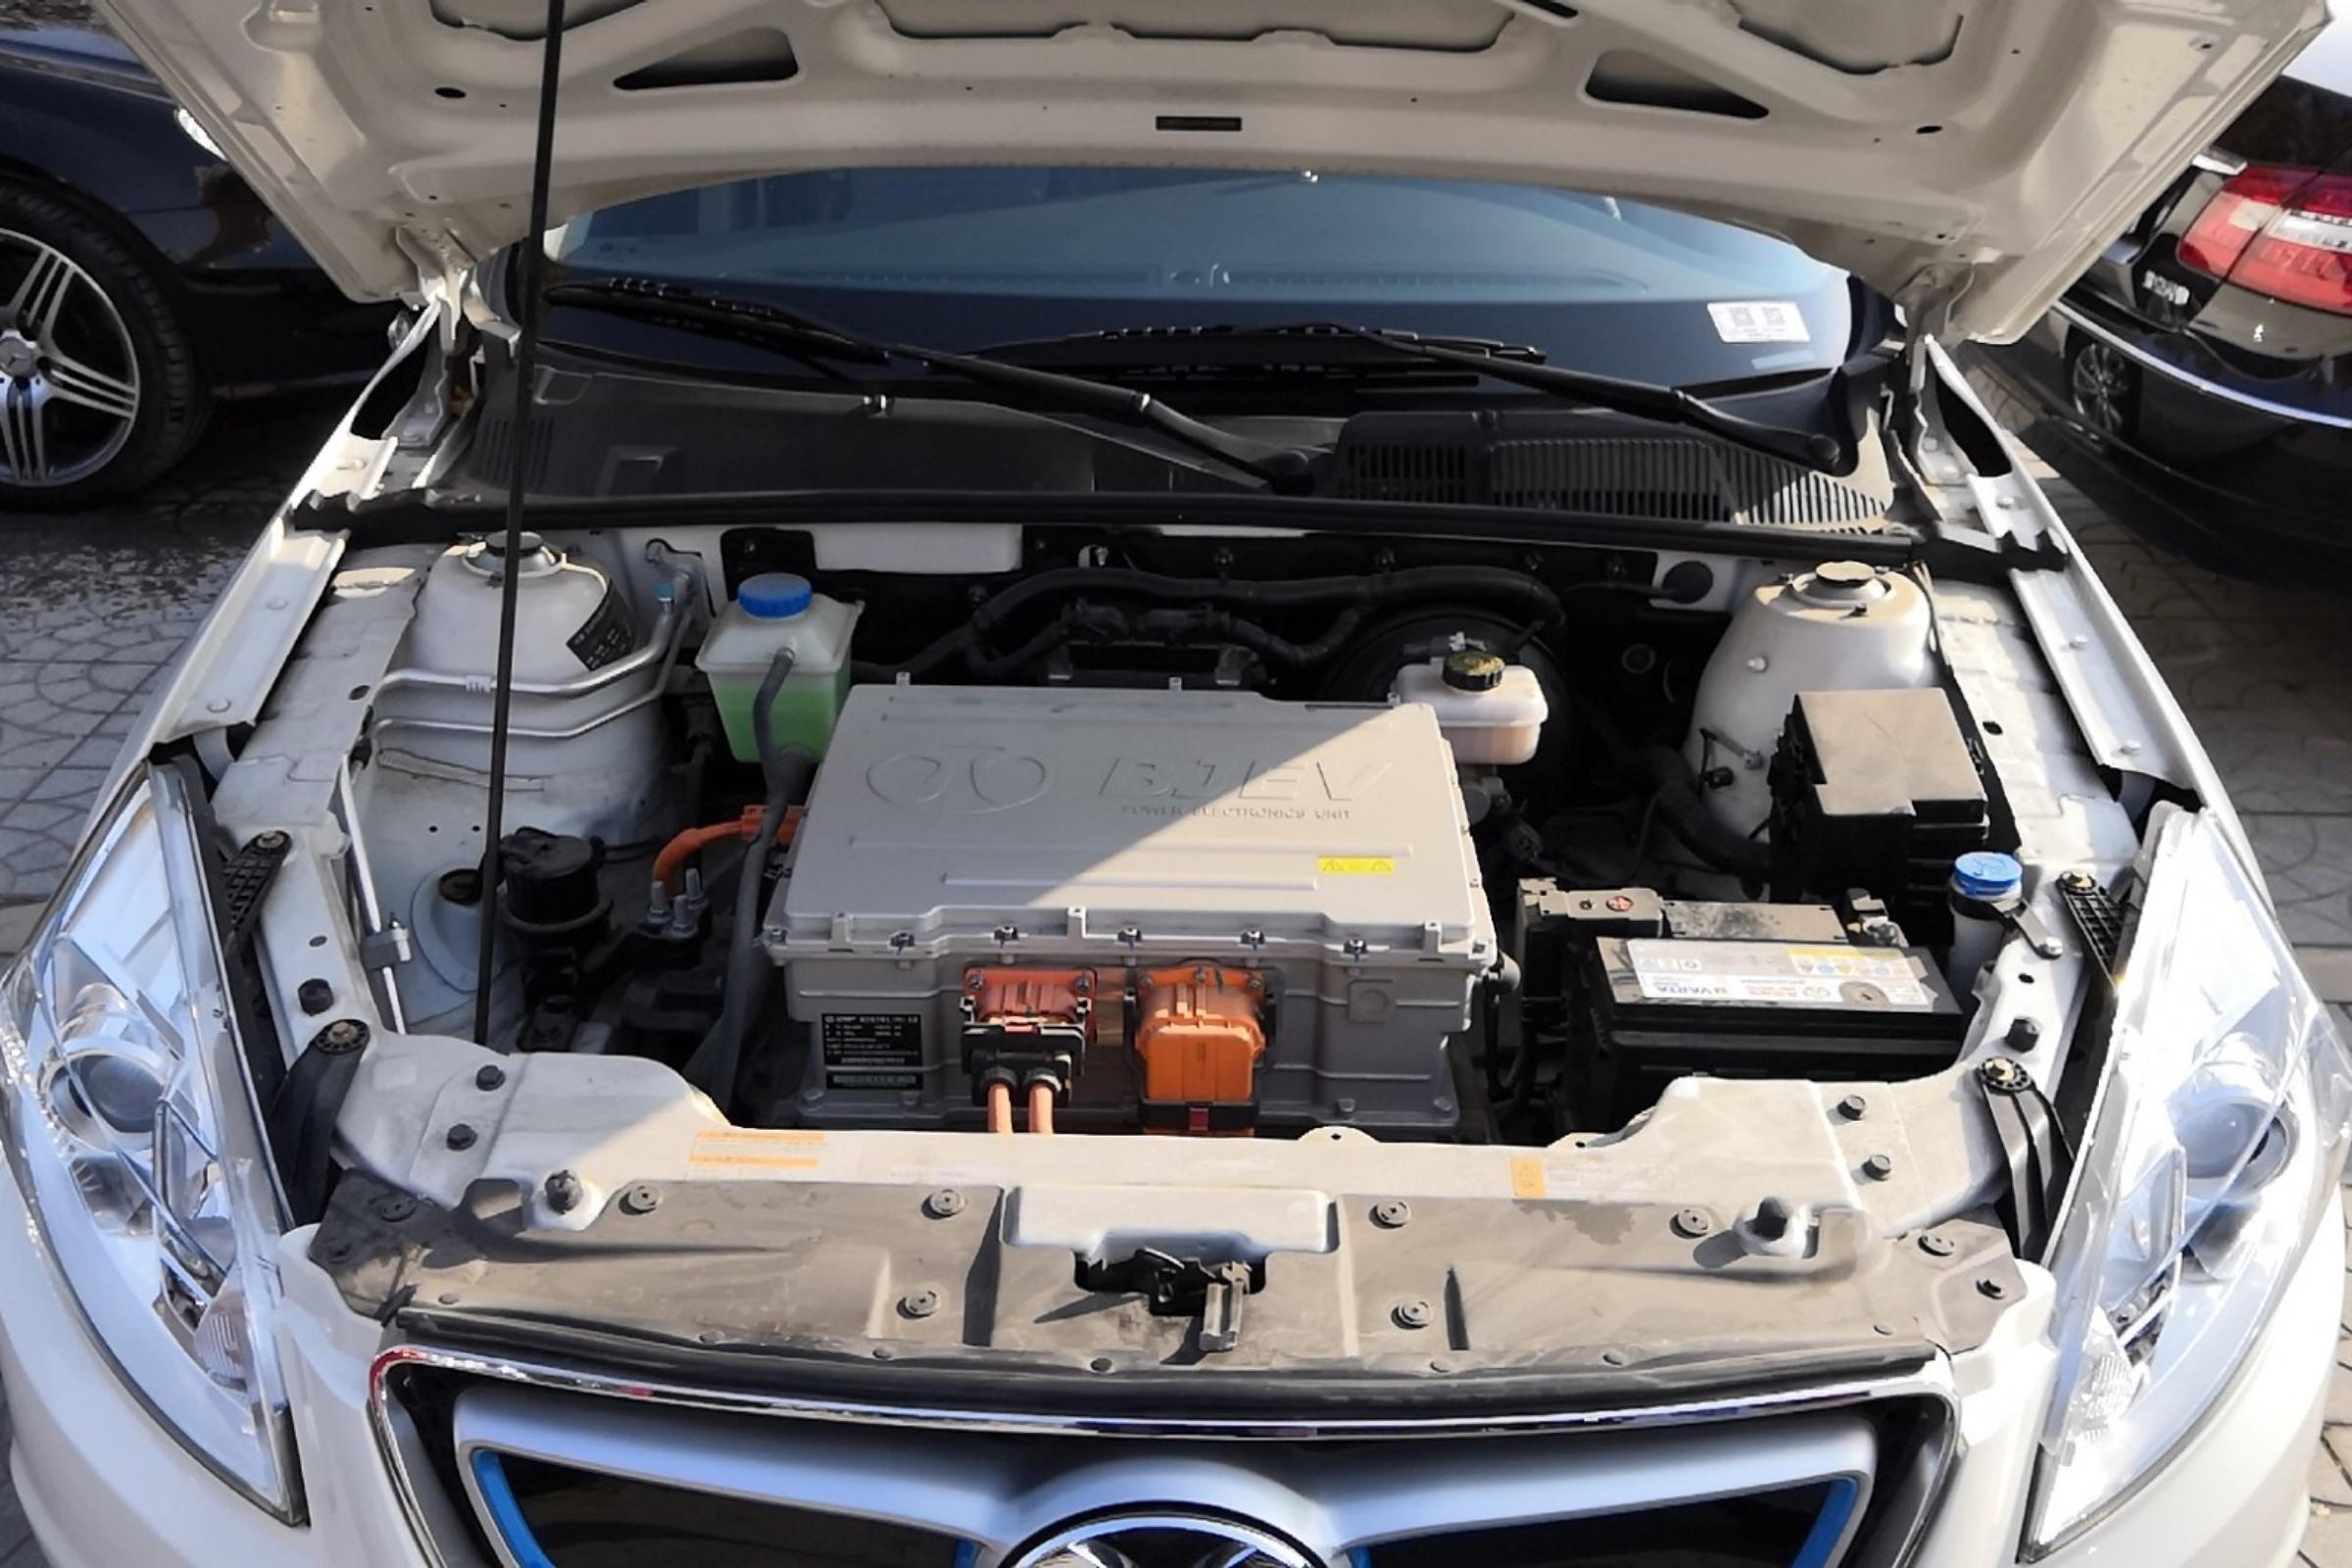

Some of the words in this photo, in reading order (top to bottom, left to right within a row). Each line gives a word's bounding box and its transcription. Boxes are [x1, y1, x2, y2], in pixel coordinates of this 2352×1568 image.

[1099, 758, 1394, 802] BJEV
[1121, 805, 1185, 817] POWER
[1191, 806, 1305, 819] ELECTRONICS
[1314, 808, 1350, 819] UNIT
[1657, 986, 1713, 995] VARTA
